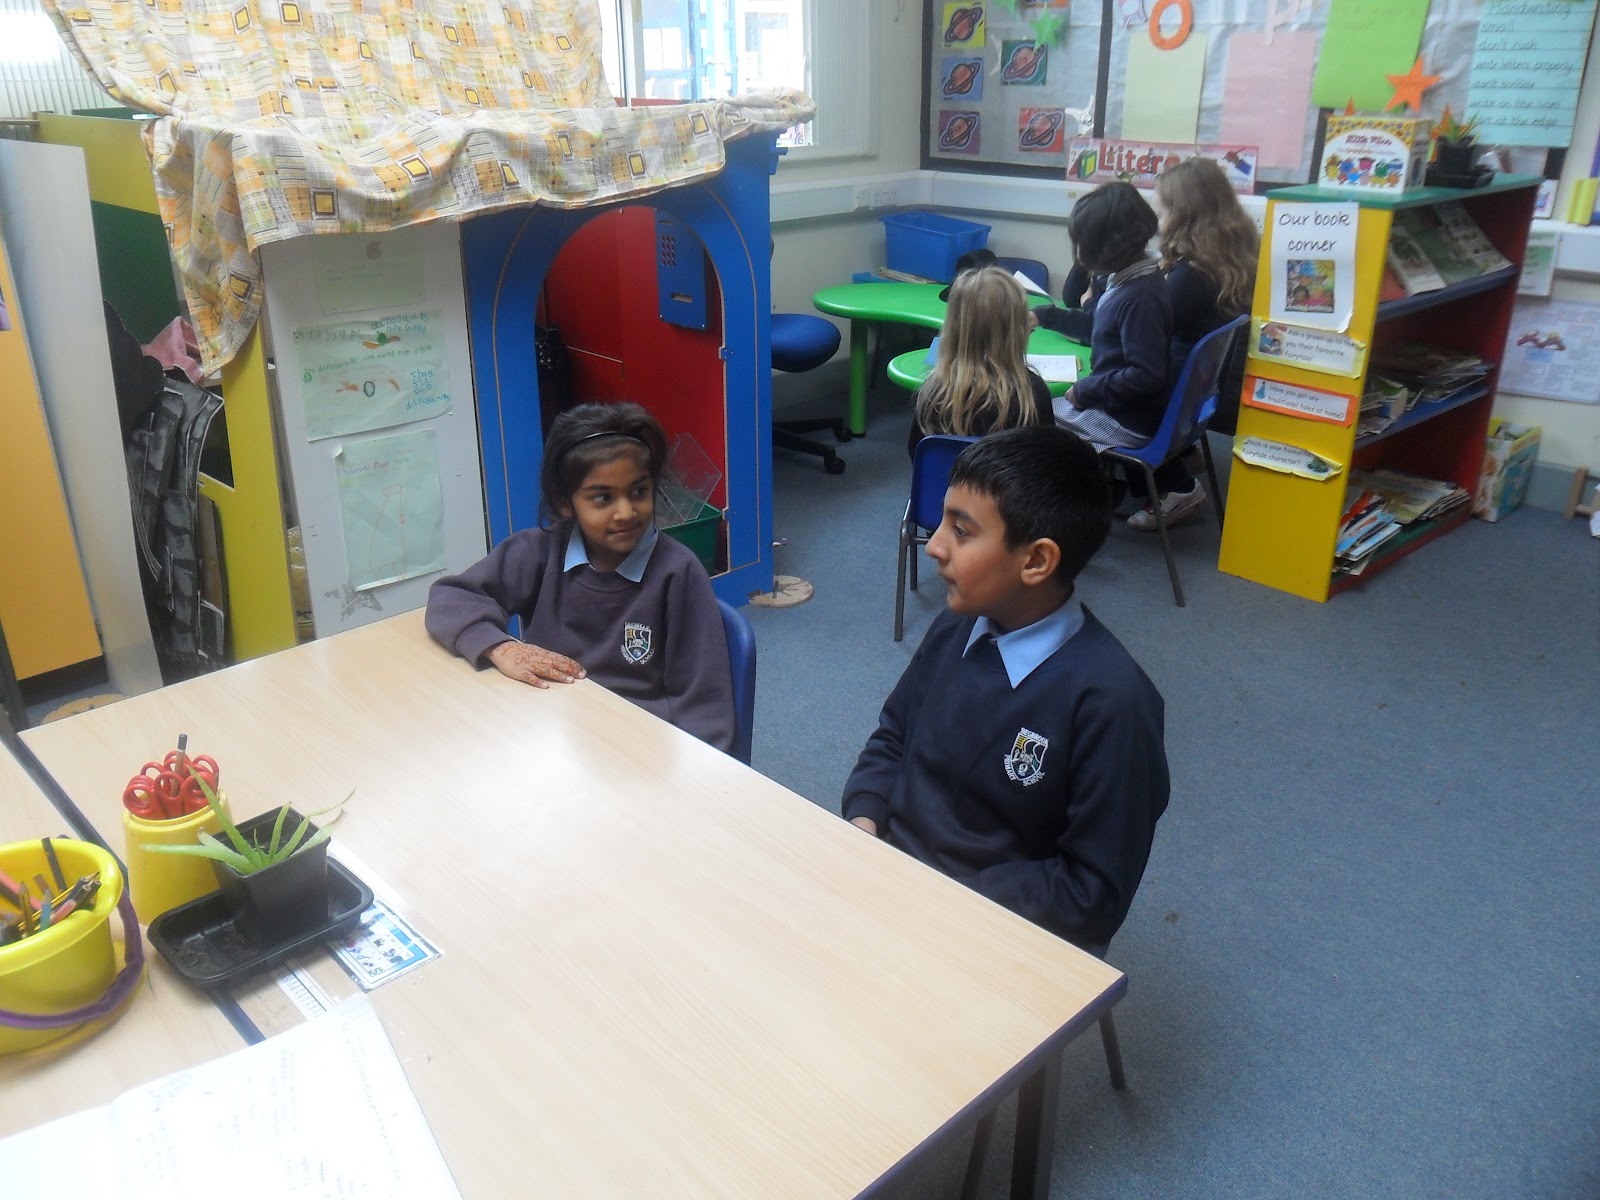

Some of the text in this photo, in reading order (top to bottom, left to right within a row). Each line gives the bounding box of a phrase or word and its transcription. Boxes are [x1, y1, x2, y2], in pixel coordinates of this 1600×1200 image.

[1489, 1, 1572, 19] Handwriting
[1481, 19, 1515, 32] small
[1478, 38, 1537, 51] don't rush
[1098, 142, 1181, 174] Litera
[1279, 210, 1351, 226] Our book
[1288, 240, 1338, 252] corner
[1315, 345, 1345, 357] favourite
[1269, 384, 1320, 403] Have you got any
[1267, 396, 1299, 408] traditional
[1300, 403, 1315, 412] tales
[1324, 409, 1344, 419] home?
[1242, 448, 1301, 465] fairytale character?
[1003, 754, 1017, 781] PRIMARY
[1023, 771, 1046, 787] SCHOOL
